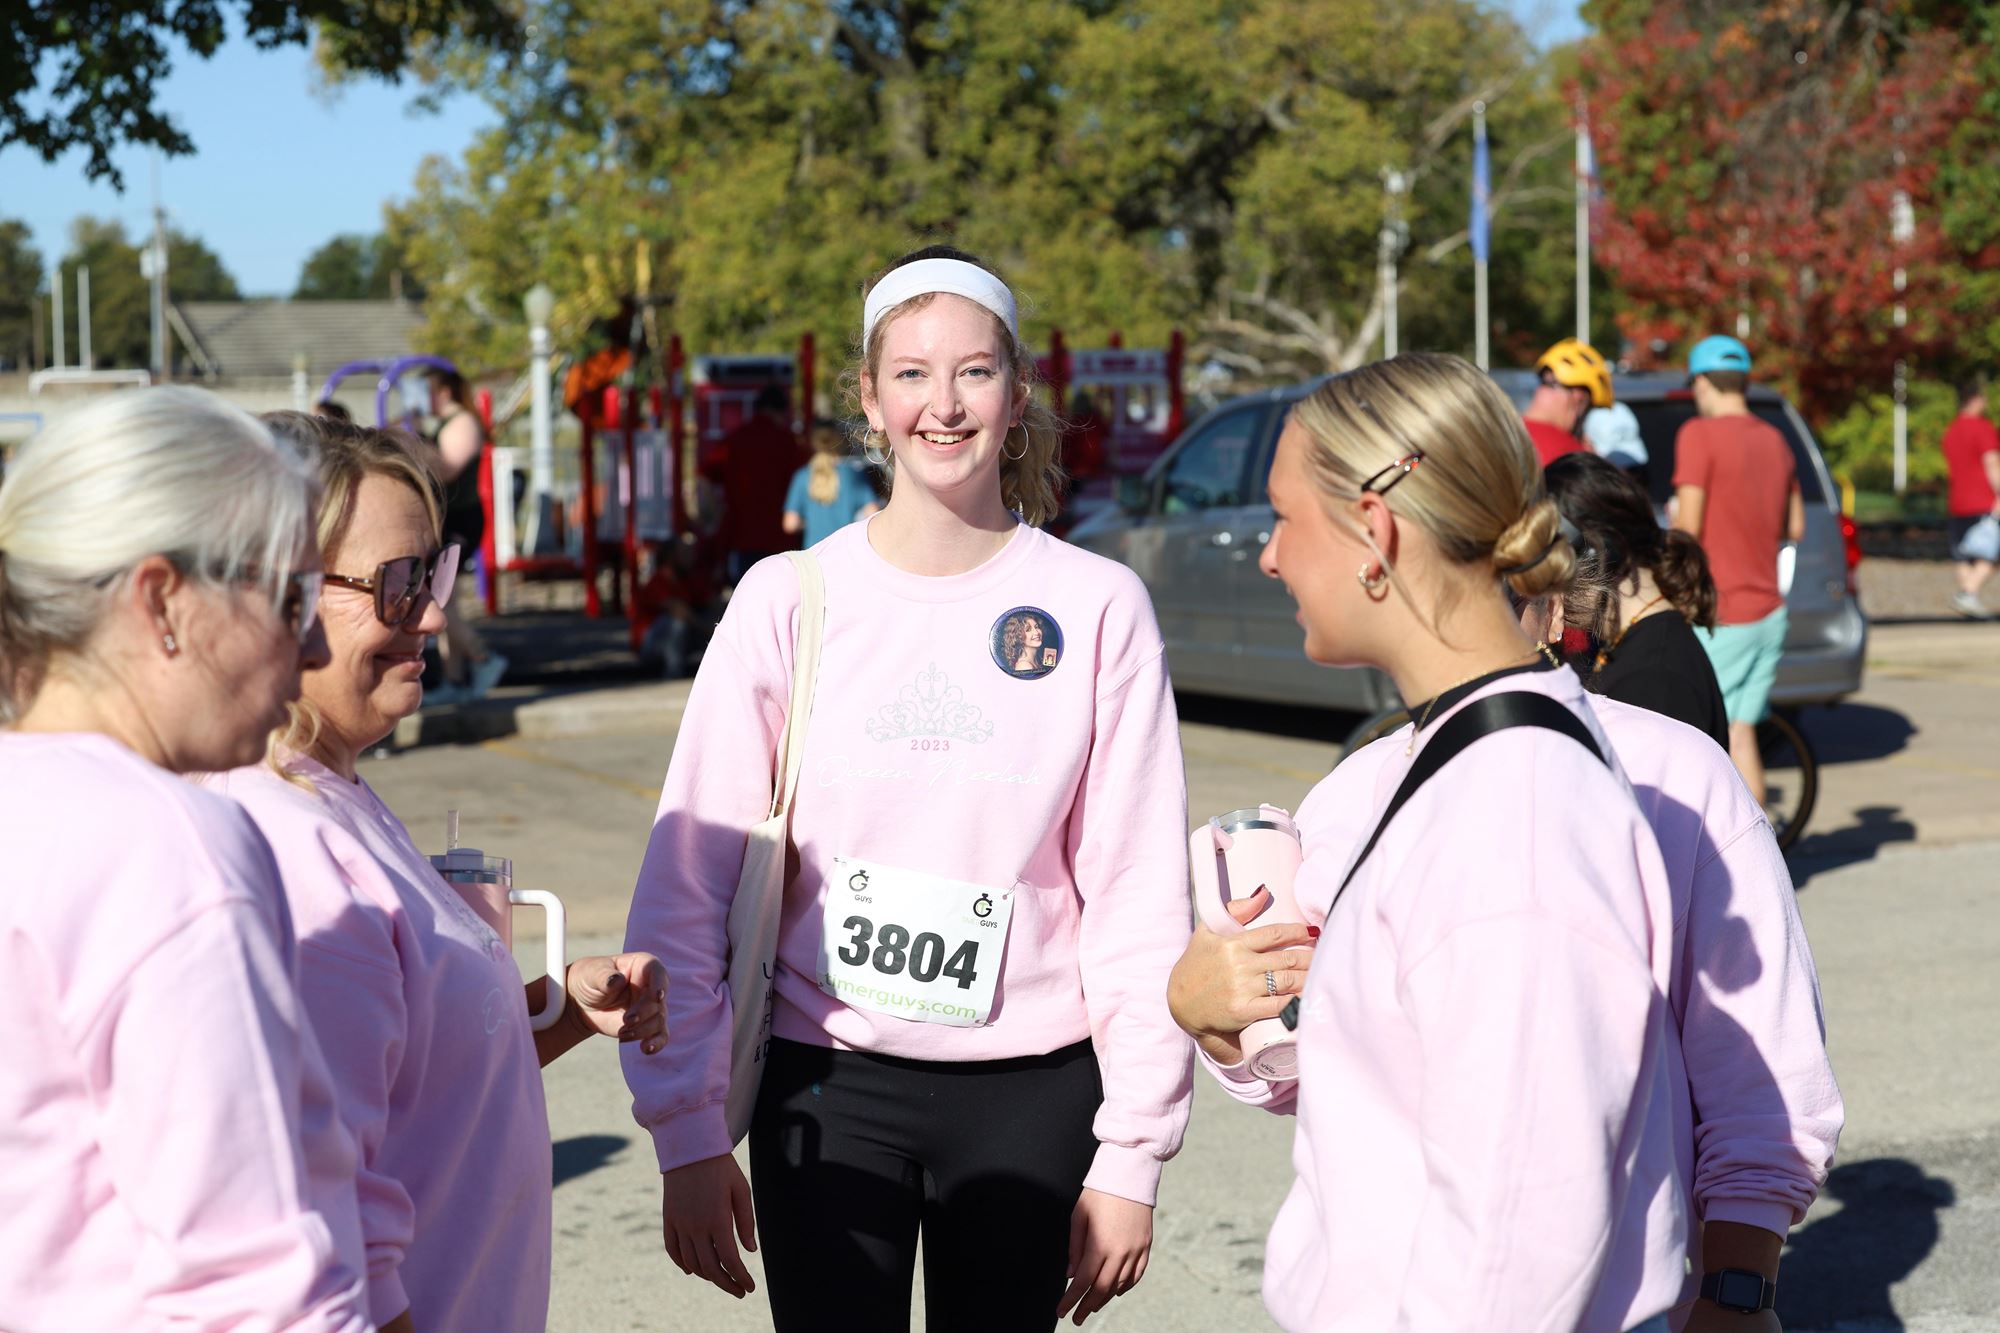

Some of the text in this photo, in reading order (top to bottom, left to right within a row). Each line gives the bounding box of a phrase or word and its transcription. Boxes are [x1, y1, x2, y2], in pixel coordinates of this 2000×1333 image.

[910, 738, 950, 752] 2023
[816, 754, 914, 791] Queen
[854, 894, 872, 904] GUYS
[980, 919, 998, 929] GUYS
[837, 915, 980, 990] 3804
[825, 971, 977, 1019] timerguys.com
